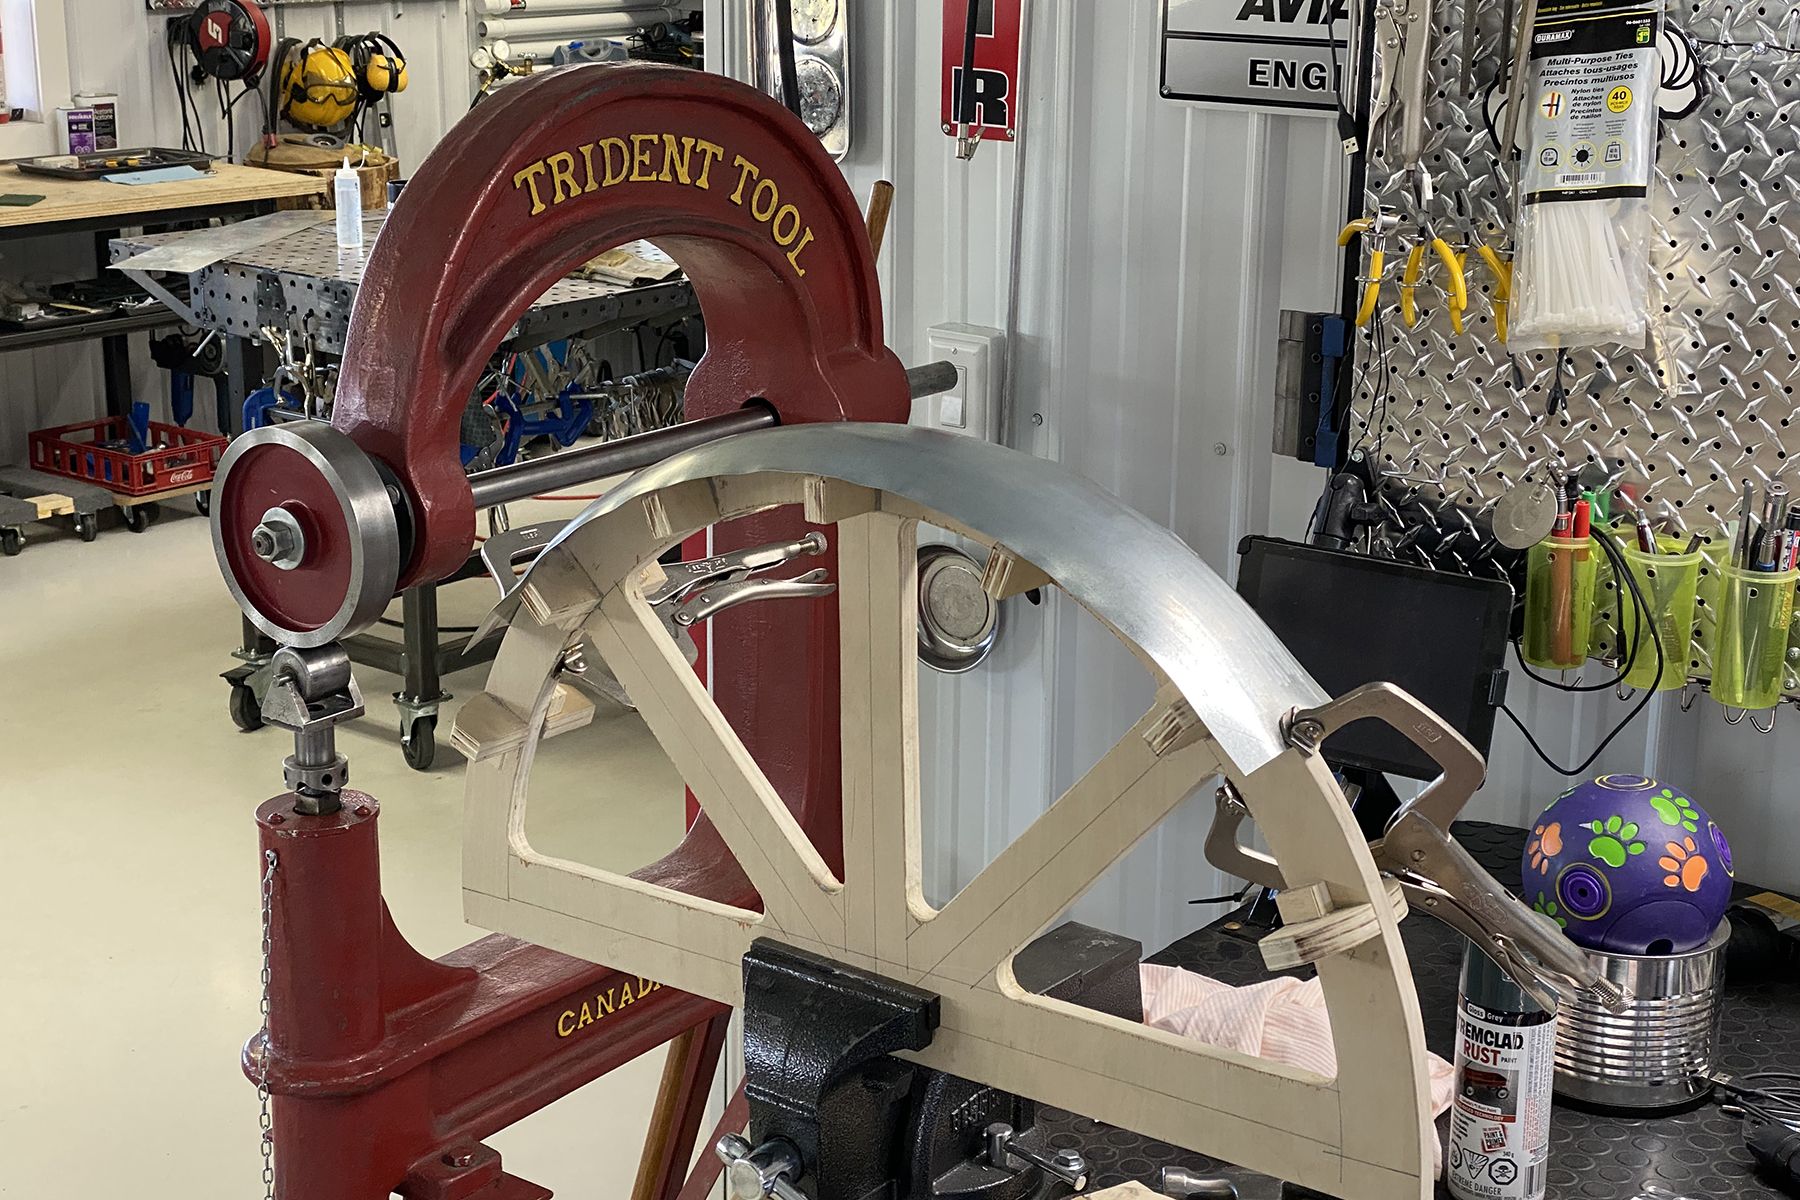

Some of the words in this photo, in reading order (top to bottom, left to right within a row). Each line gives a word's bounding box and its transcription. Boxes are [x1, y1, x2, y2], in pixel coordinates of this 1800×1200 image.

[1536, 30, 1572, 42] DURAMAX
[1547, 55, 1613, 67] Multi-Purpose
[1615, 52, 1634, 60] Ties
[1540, 67, 1581, 77] Attaches
[1583, 62, 1639, 74] tous-usages
[1544, 78, 1588, 87] Precintos
[1591, 73, 1635, 84] multiusos
[1612, 91, 1627, 100] 40
[1570, 106, 1602, 114] Precintos
[514, 133, 724, 216] TRIDENT
[730, 154, 814, 277] TOOL
[1468, 1005, 1484, 1017] Gloss
[1487, 1013, 1503, 1023] Grey
[1463, 1039, 1501, 1066] RUST
[1474, 1181, 1502, 1196] DANGER
